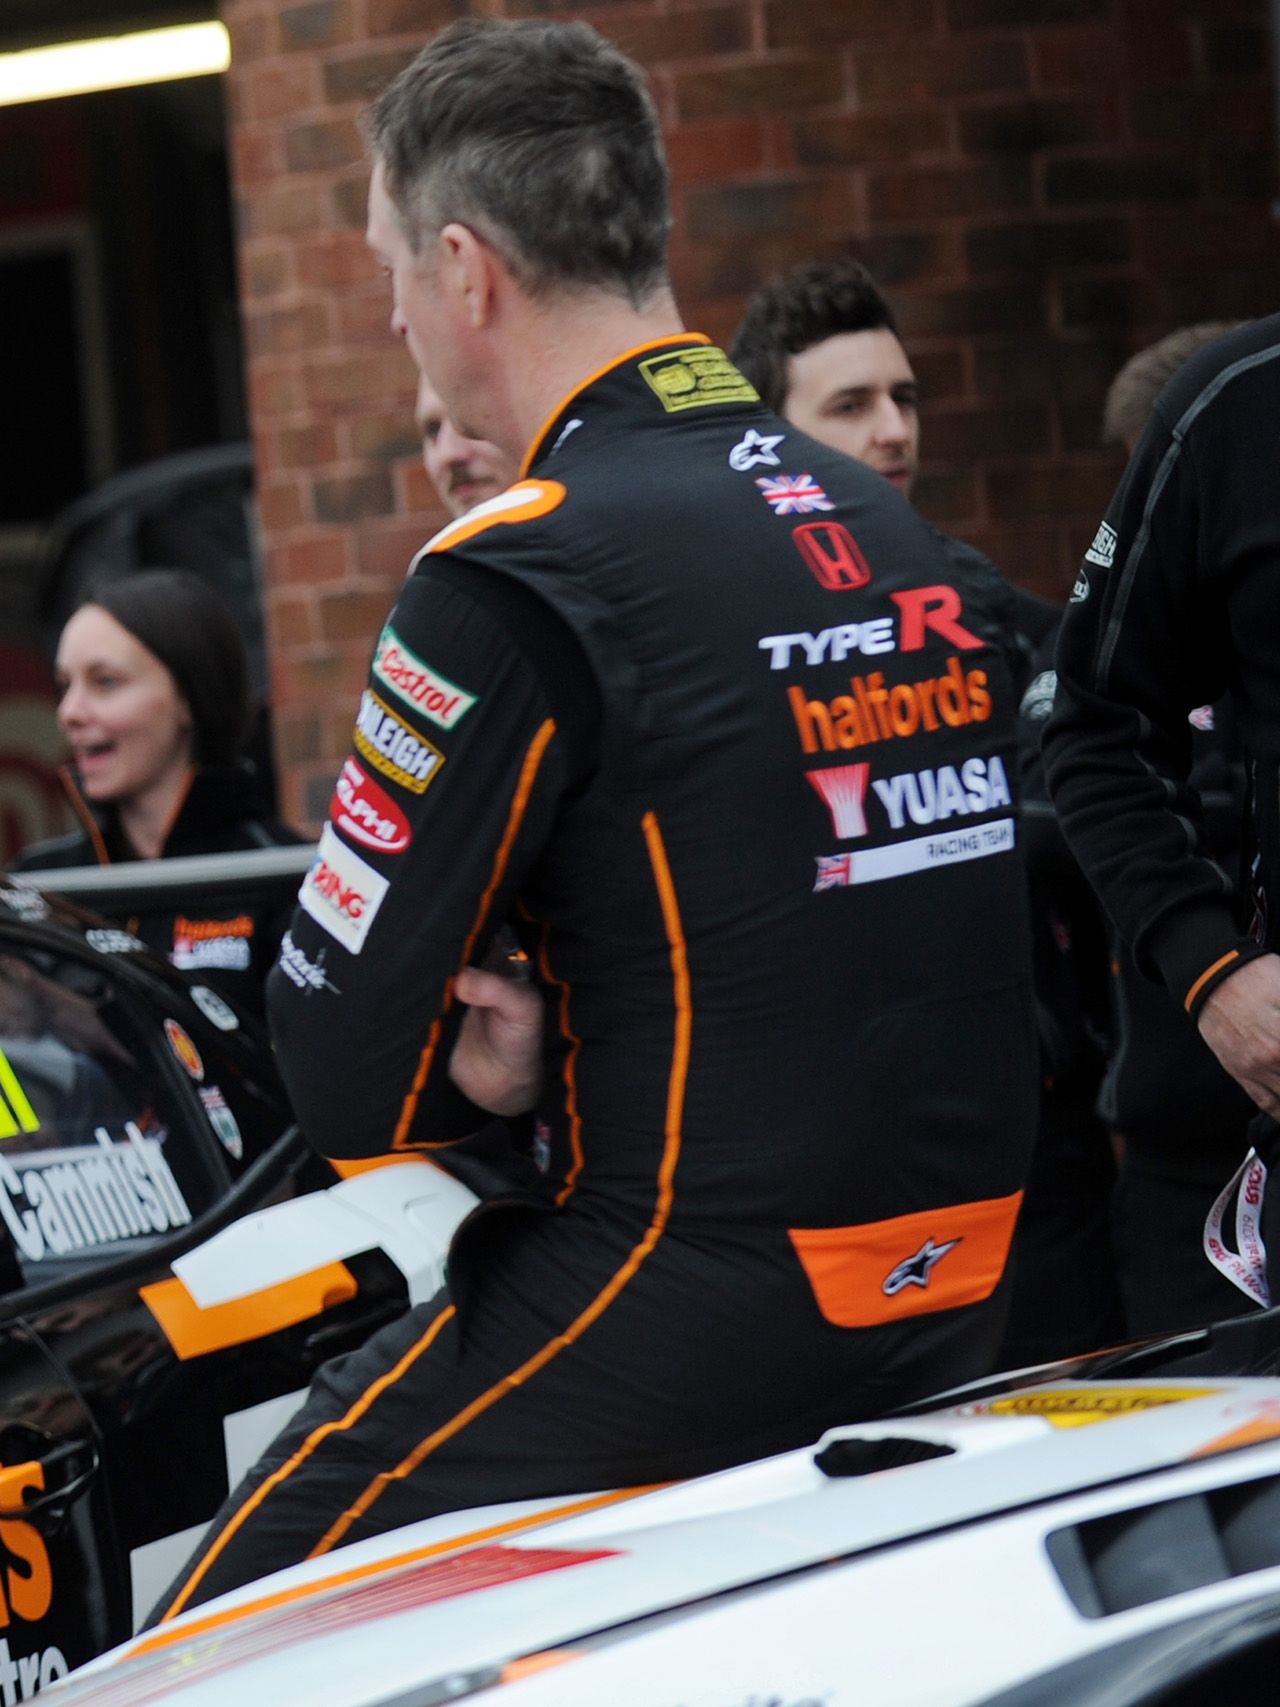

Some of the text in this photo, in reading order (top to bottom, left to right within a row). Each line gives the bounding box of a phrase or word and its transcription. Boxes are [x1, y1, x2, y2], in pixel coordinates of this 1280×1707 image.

[758, 584, 986, 671] TYPE R
[381, 648, 460, 721] Castrol
[787, 656, 992, 754] halfords
[871, 756, 1012, 829] YUASA
